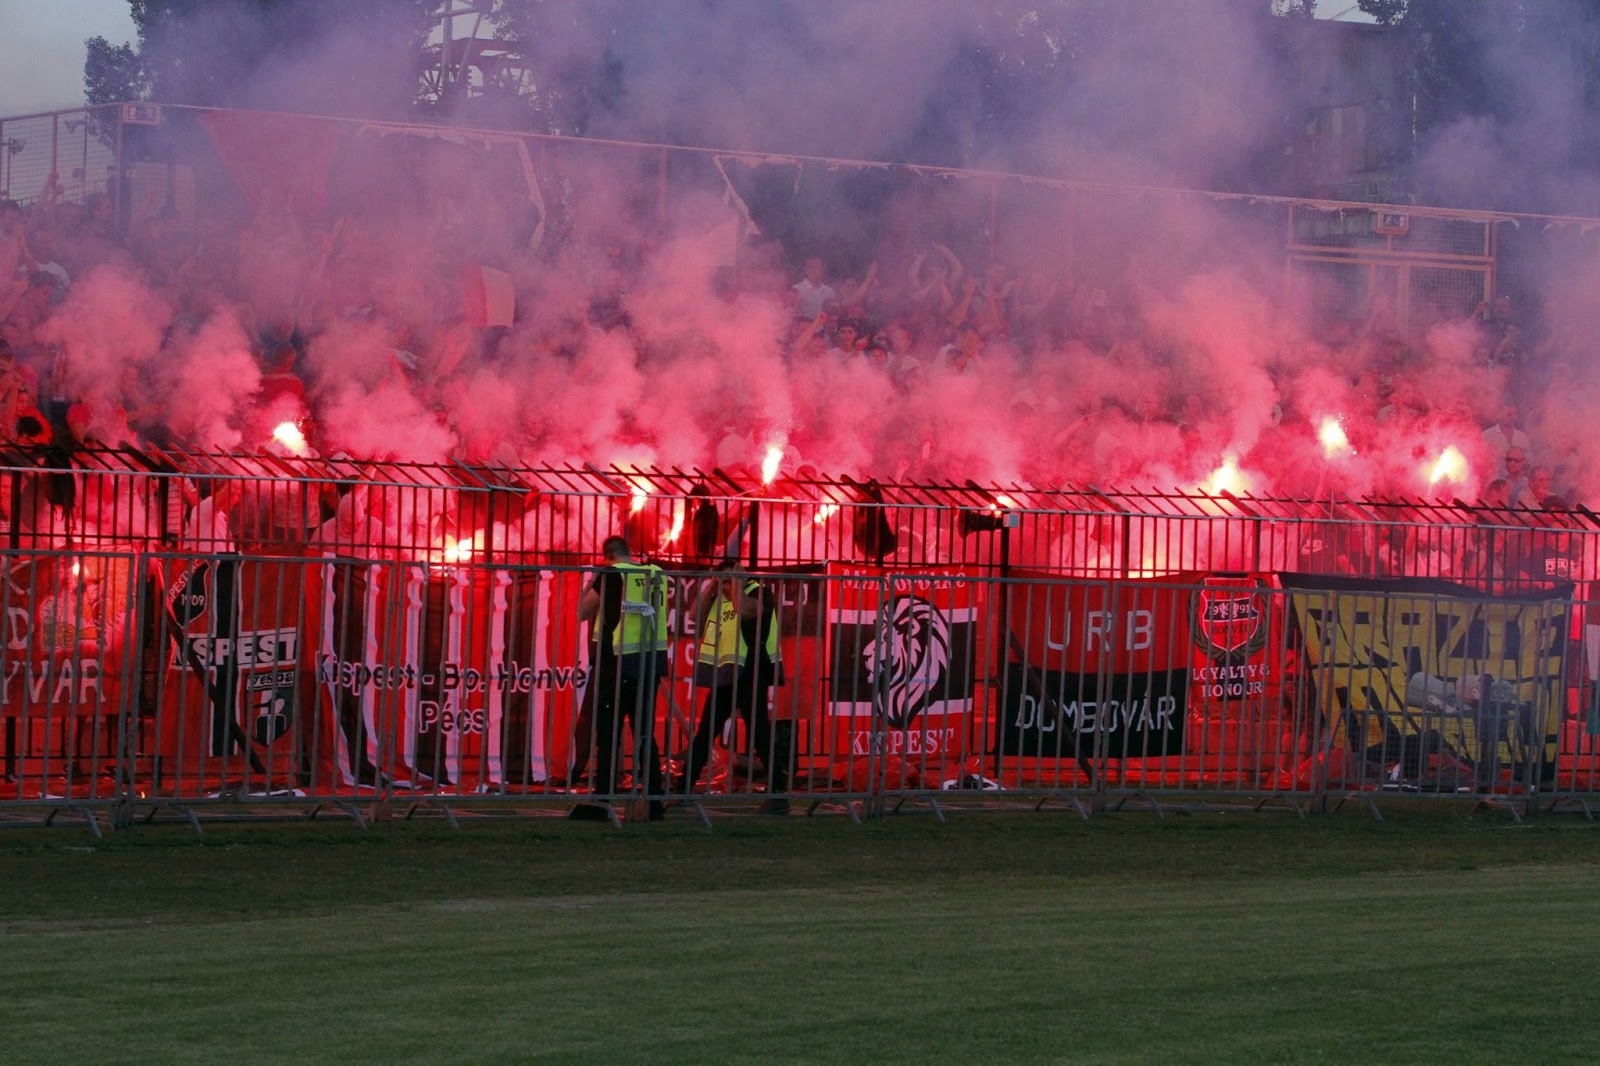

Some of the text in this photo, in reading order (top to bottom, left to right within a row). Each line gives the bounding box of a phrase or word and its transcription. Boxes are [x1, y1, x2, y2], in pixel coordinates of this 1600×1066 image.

[172, 633, 298, 667] SPEST
[497, 657, 587, 695] Honvé
[1192, 666, 1258, 681] LOYALTY
[1202, 682, 1263, 698] HONOUR
[419, 701, 489, 734] Pécs
[848, 728, 954, 755] KIPEST
